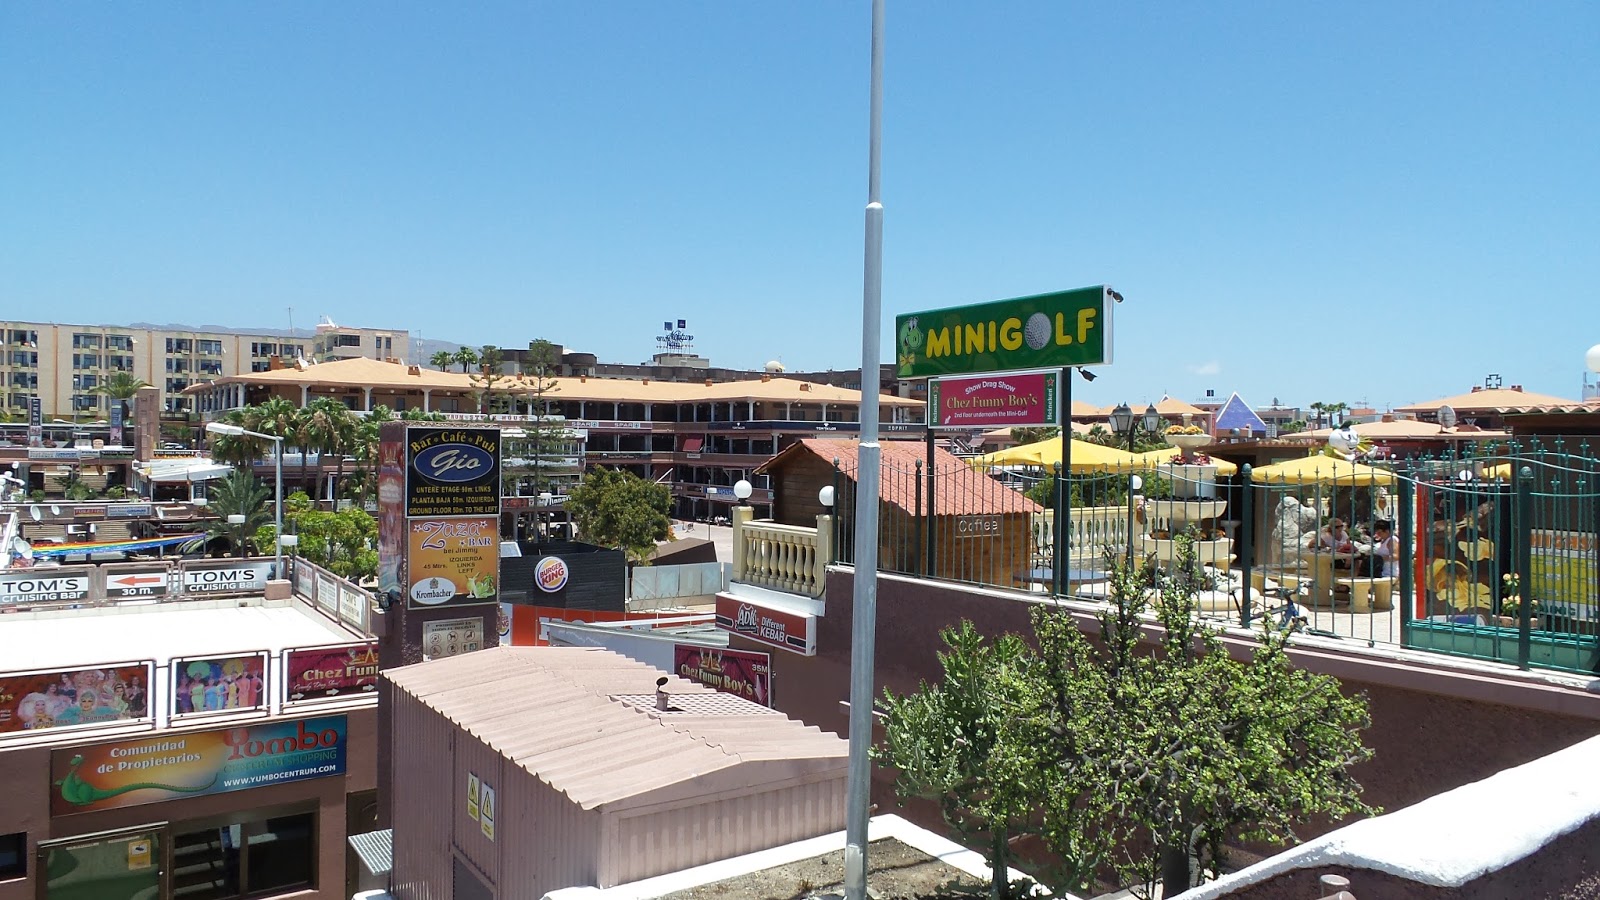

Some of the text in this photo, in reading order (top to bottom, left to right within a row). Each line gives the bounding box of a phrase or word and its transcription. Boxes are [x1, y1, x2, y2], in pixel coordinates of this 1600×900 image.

[965, 381, 1016, 395] Show Drag Show
[946, 394, 1038, 409] Chez Funny Boy's
[411, 431, 495, 453] Bar Café Pub
[431, 449, 481, 476] Gio
[421, 521, 480, 550] Zaza
[468, 537, 492, 547] BAR
[190, 569, 255, 583] TOM'S
[540, 562, 563, 578] BURGER
[541, 567, 564, 586] KING
[2, 579, 79, 594] TOM'S
[121, 588, 136, 596] 30
[416, 589, 452, 599] Krombacher
[738, 609, 757, 626] ADK
[761, 616, 786, 631] Different
[760, 626, 785, 642] KEBAB
[303, 665, 378, 681] Chez Fun
[752, 664, 768, 673] 35M
[681, 664, 753, 696] Chez Funny Boy's
[223, 720, 338, 761] Yumbo
[111, 740, 186, 758] Comunidad
[97, 752, 201, 774] de Propietarios
[287, 750, 337, 767] SHOPPING
[224, 764, 336, 787] WWW.YUMBOCENTRUM.COM
